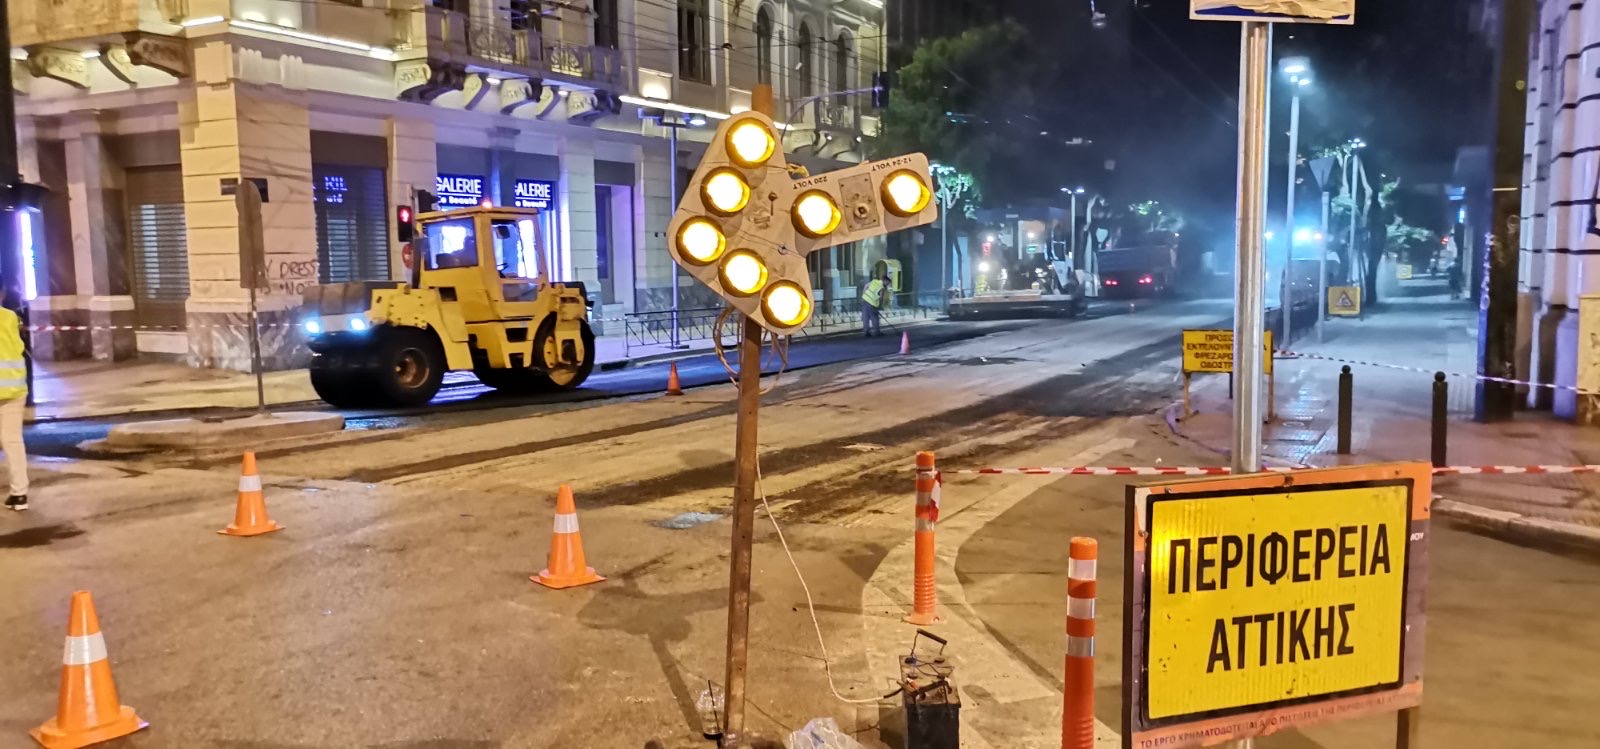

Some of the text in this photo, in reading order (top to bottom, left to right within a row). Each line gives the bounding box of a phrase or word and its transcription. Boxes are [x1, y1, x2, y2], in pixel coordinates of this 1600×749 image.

[872, 162, 891, 172] VOLT
[793, 175, 828, 190] 220 VOLT
[280, 259, 316, 279] DRESS
[1205, 334, 1234, 342] ΠΡΟΣΟ
[1200, 361, 1234, 369] ΟΔΟΣΤΡ
[1167, 523, 1391, 595] ΠΕΡΙΦΕΡΕΙΑ
[1206, 603, 1356, 674] ΑΤΤΙΚΗΣ
[1154, 735, 1176, 747] ΕΡΓΟ
